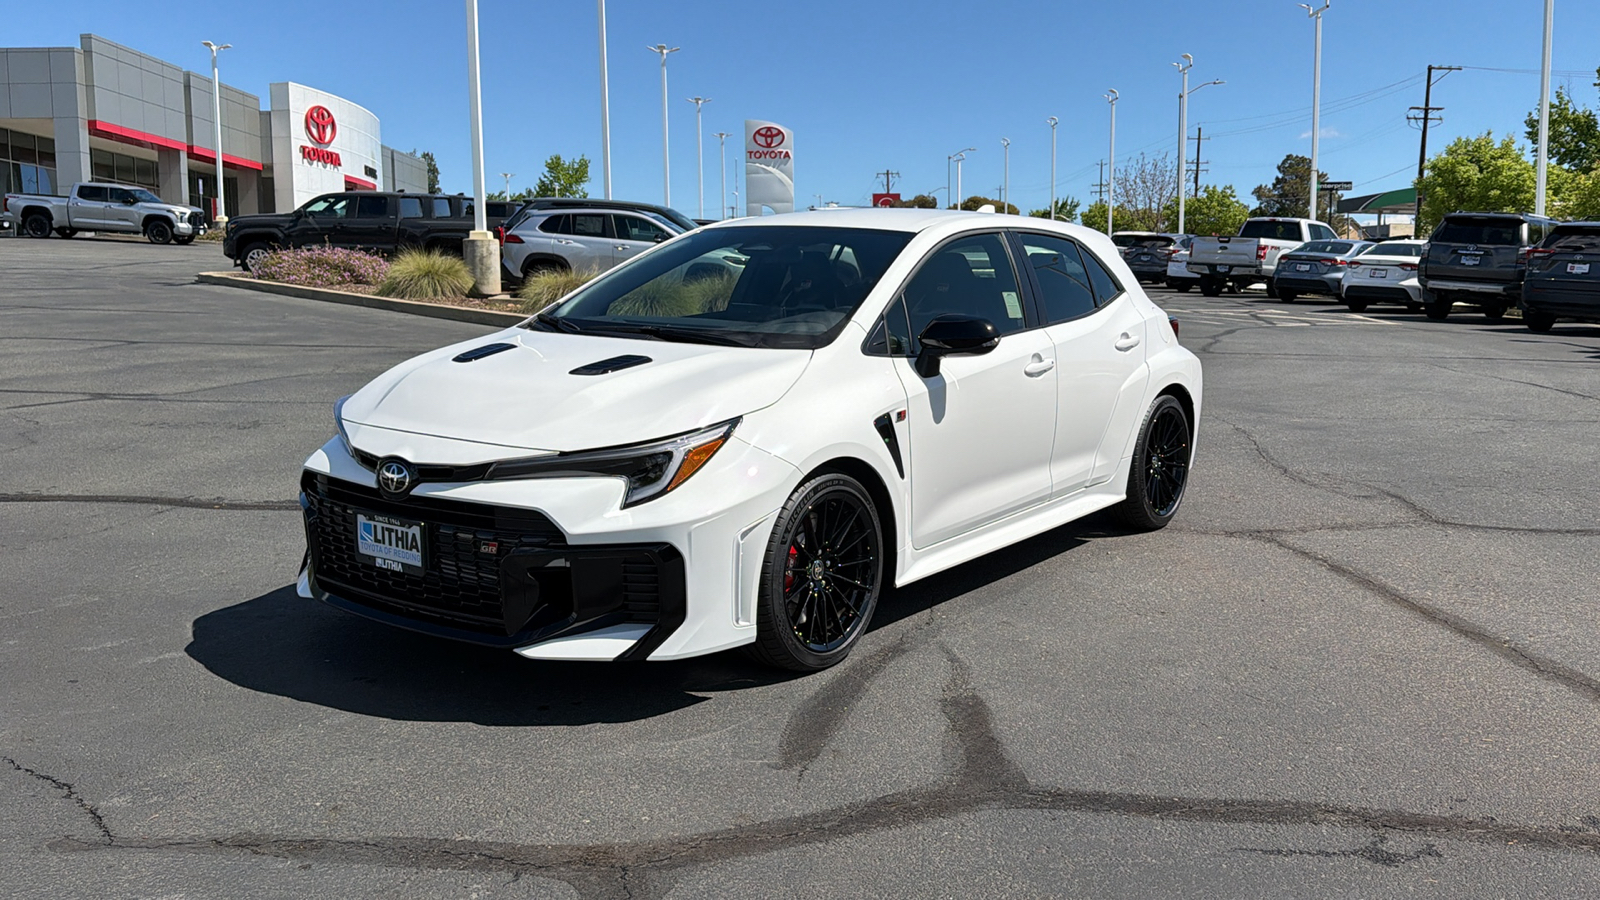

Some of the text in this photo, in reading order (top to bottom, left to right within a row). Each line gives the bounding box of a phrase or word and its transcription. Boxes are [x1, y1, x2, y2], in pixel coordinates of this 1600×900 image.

[300, 145, 342, 167] TOYOTA
[747, 150, 791, 160] TOYOTA
[786, 489, 815, 531] MICHELIN
[374, 515, 388, 524] SINCE
[373, 523, 420, 553] LITHIA
[360, 541, 421, 563] TOYOTA OF REDDING
[480, 545, 497, 554] GR
[382, 558, 404, 573] LITHIA
